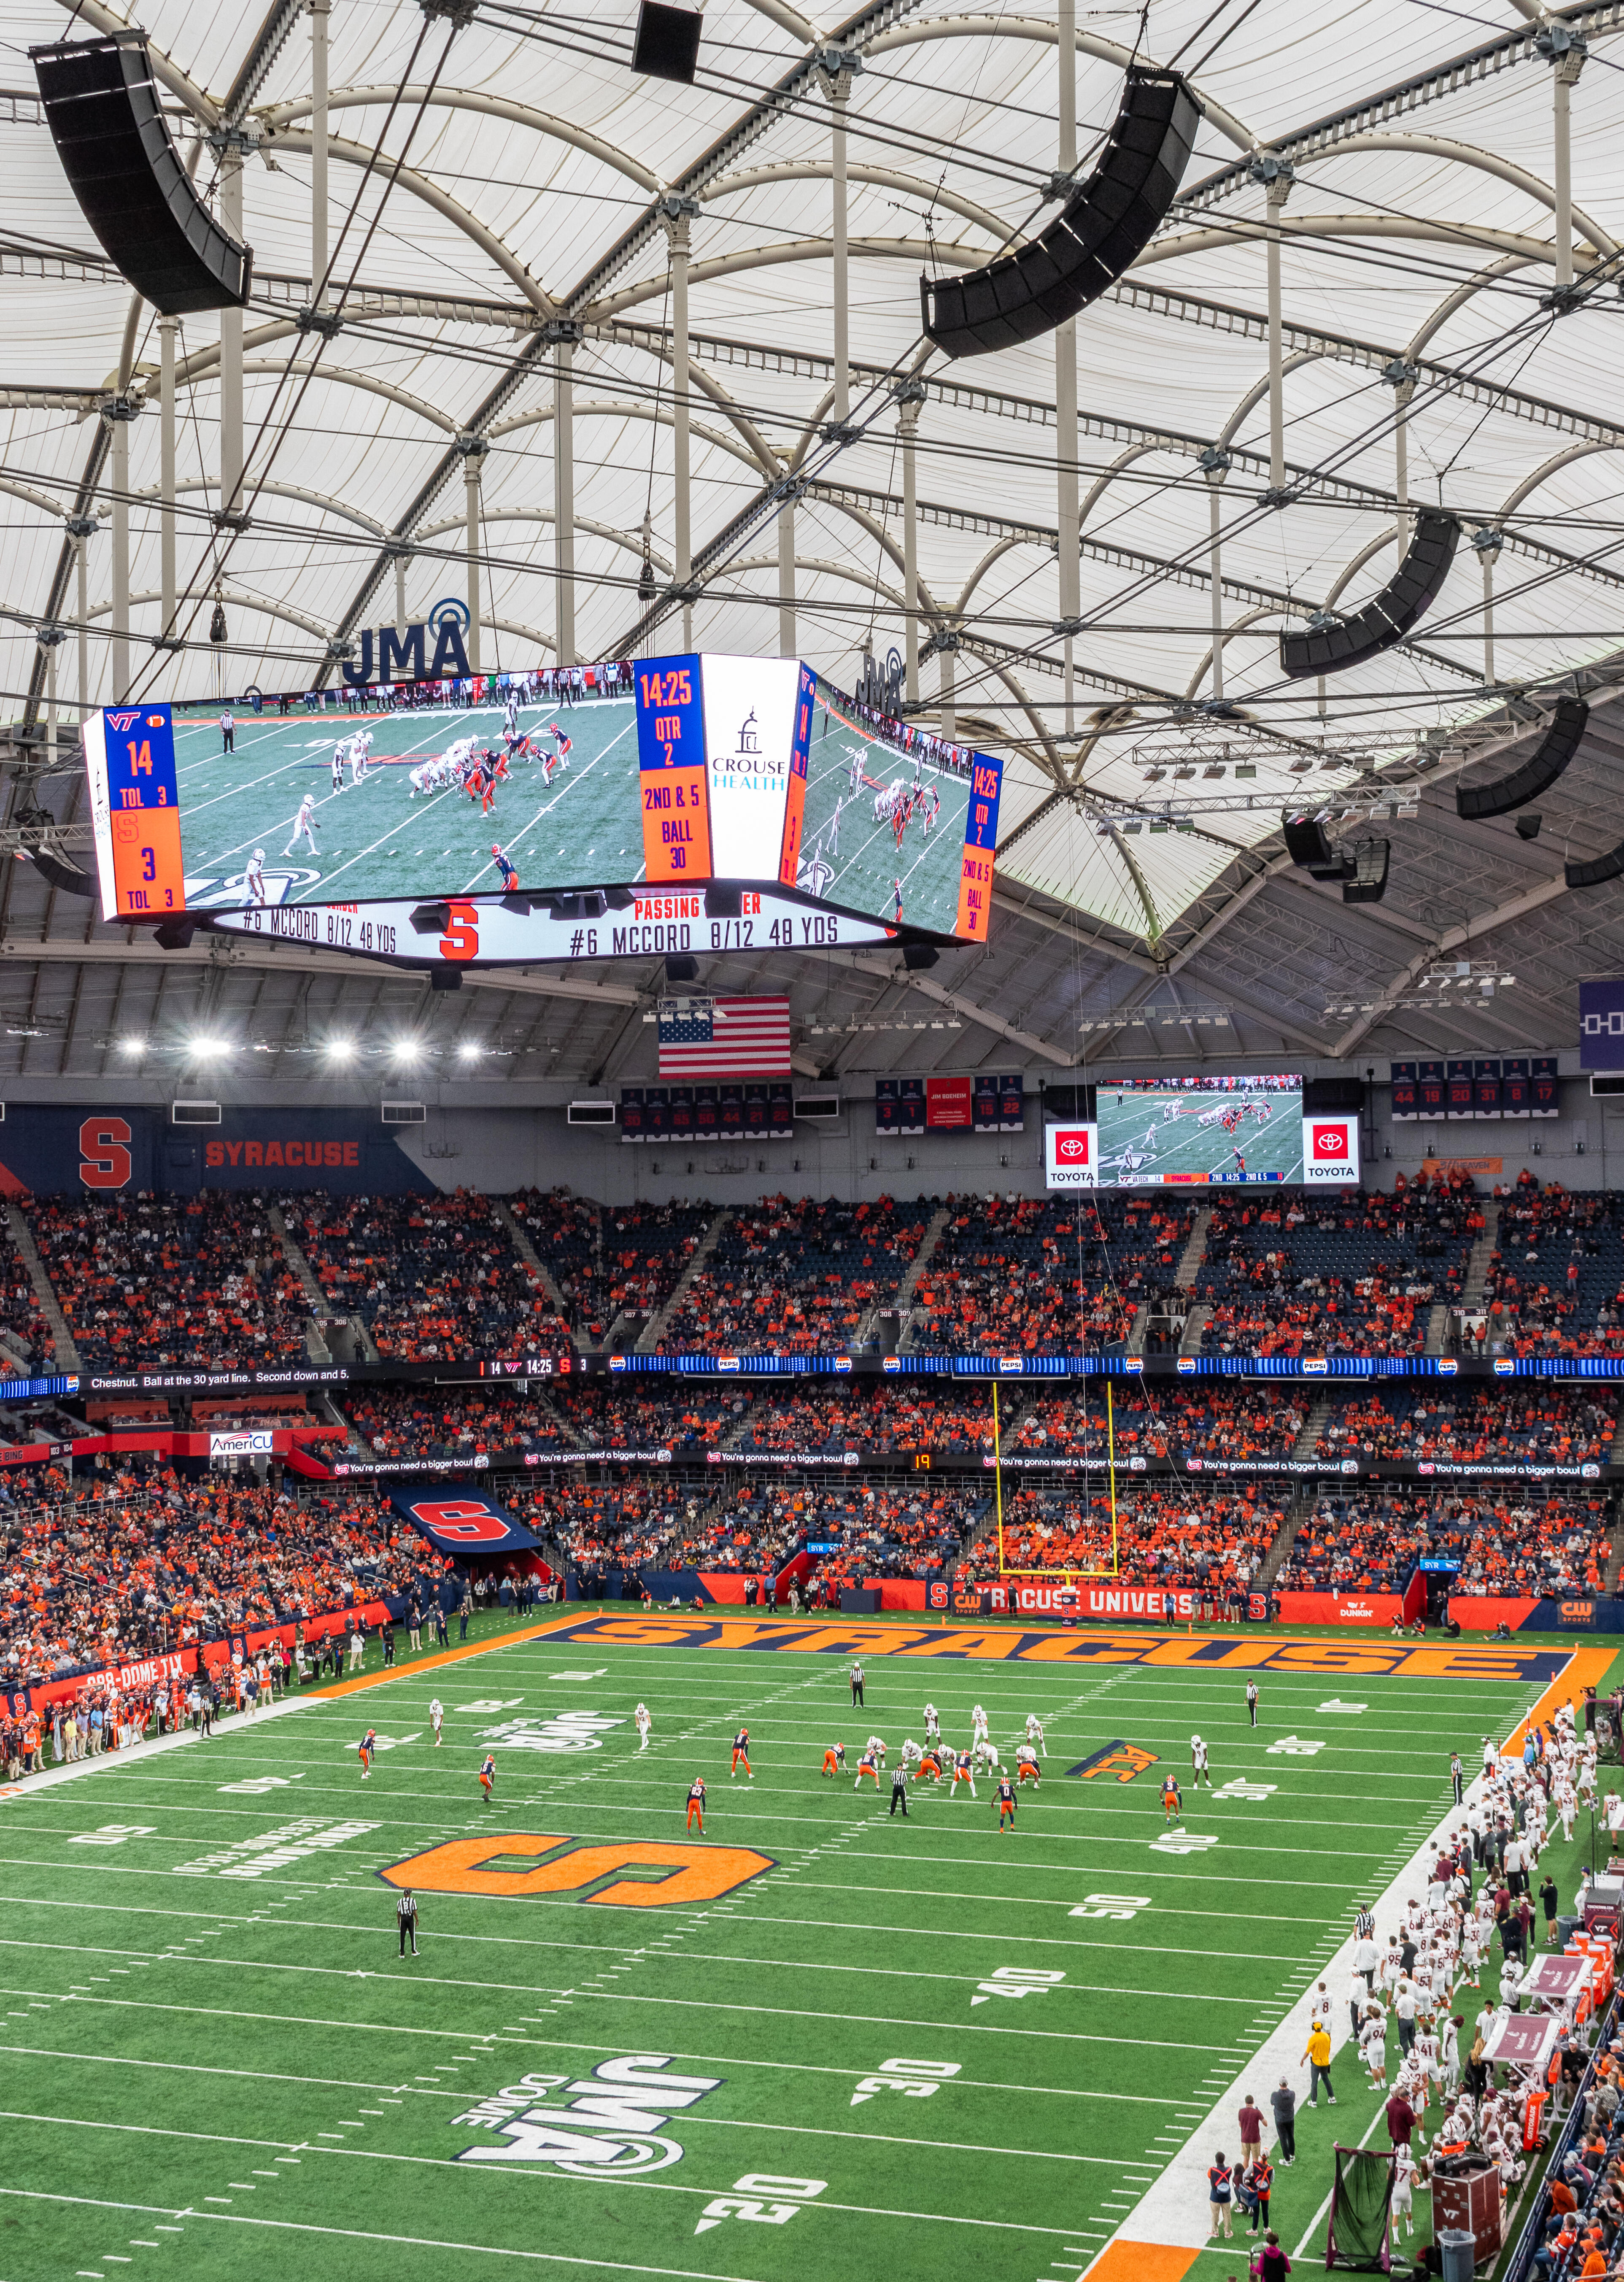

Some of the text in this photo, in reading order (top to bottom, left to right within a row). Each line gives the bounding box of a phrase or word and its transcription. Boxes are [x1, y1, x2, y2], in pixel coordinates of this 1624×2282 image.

[343, 621, 471, 684] JMA
[640, 670, 691, 708] 14:25
[106, 712, 141, 731] VT
[656, 716, 681, 741] QTR
[127, 740, 153, 776] 14
[664, 743, 674, 766] 2
[713, 758, 785, 775] CROUSE
[714, 775, 784, 791] HEALTH
[974, 766, 998, 799] 14:25
[120, 786, 167, 807] TOL 3
[645, 785, 699, 810] 2ND & 5
[976, 803, 988, 825] QTR
[116, 812, 139, 843] S
[662, 820, 693, 843] BALL
[977, 825, 982, 845] 2
[141, 847, 156, 881] 3
[671, 847, 686, 868] 30
[963, 859, 989, 882] 2ND & 5
[127, 888, 173, 909] TOL 3
[635, 897, 699, 921] PASSING
[967, 888, 982, 909] BALL
[243, 909, 396, 953] #6 MCCORD 8/12 48 YDS
[968, 912, 977, 929] 30
[440, 905, 478, 960] S
[570, 916, 837, 956] #6 MCCORD 8/12 48 YDS
[1481, 1088, 1495, 1101] 31
[1538, 1087, 1553, 1099] 17
[883, 1107, 891, 1118] 3
[909, 1107, 914, 1117] 1
[1004, 1102, 1020, 1113] 22
[80, 1117, 131, 1188] S
[206, 1141, 359, 1167] SYRACUSE
[1050, 1172, 1095, 1182] TOYOTA
[1308, 1167, 1355, 1177] TOYOTA
[491, 1358, 587, 1375] 14 VT 14:25 S 3
[92, 1369, 349, 1388] Chestnut. Ball at the 30 yard line. Second down and 5.
[50, 1447, 60, 1455] 103
[63, 1444, 73, 1452] 104
[211, 1436, 272, 1451] AmeriCU
[4, 1450, 23, 1461] BING
[351, 1464, 373, 1472] You're
[375, 1464, 399, 1473] gonna
[401, 1461, 420, 1470] need
[428, 1459, 453, 1470] bigger
[454, 1458, 473, 1466] bowl
[563, 1454, 585, 1463] gonna
[586, 1451, 605, 1460] need
[613, 1451, 637, 1461] bigger
[638, 1451, 656, 1459] bowl
[916, 1455, 930, 1469] 19
[1203, 1460, 1228, 1469] You're
[1230, 1462, 1256, 1471] gonna
[1258, 1461, 1279, 1470] need
[1288, 1462, 1316, 1472] bigger
[1318, 1462, 1340, 1471] bowl
[1435, 1464, 1462, 1473] You're
[1464, 1466, 1492, 1475] gonna
[1493, 1465, 1516, 1474] need
[1526, 1465, 1555, 1476] bigger
[1557, 1466, 1580, 1475] bowl
[410, 1500, 512, 1542] S
[810, 1544, 824, 1552] SYR
[1424, 1561, 1439, 1569] SYR
[931, 1582, 948, 1608] S
[954, 1595, 981, 1609] CW
[1248, 1593, 1266, 1619] S
[1340, 1609, 1373, 1618] DUNKIN'
[1561, 1601, 1592, 1616] CW
[568, 1621, 1538, 1680] SYRACUSE
[475, 1712, 630, 1748] JMA
[1266, 1739, 1326, 1755] 20
[1081, 1744, 1163, 1783] ACC
[1211, 1782, 1278, 1801] 30
[67, 1824, 159, 1845] 50
[1149, 1833, 1219, 1855] 40
[172, 1818, 333, 1873] LEGENDS FIELD
[219, 1821, 383, 1877] ERNIE DAVIS
[374, 1833, 781, 1907] S
[1068, 1894, 1152, 1920] 50
[1420, 1939, 1426, 1950] 8
[1388, 1954, 1402, 1965] 95
[977, 1966, 1066, 1999] 40
[1322, 2001, 1329, 2013] 8
[1420, 2046, 1432, 2057] 41
[854, 2058, 963, 2098] 30
[449, 2055, 728, 2163] JMA
[450, 2073, 570, 2129] DOME
[1527, 2104, 1537, 2140] GATORADE
[1395, 2167, 1408, 2182] 17
[701, 2173, 829, 2225] 20
[1443, 2208, 1460, 2220] VT
